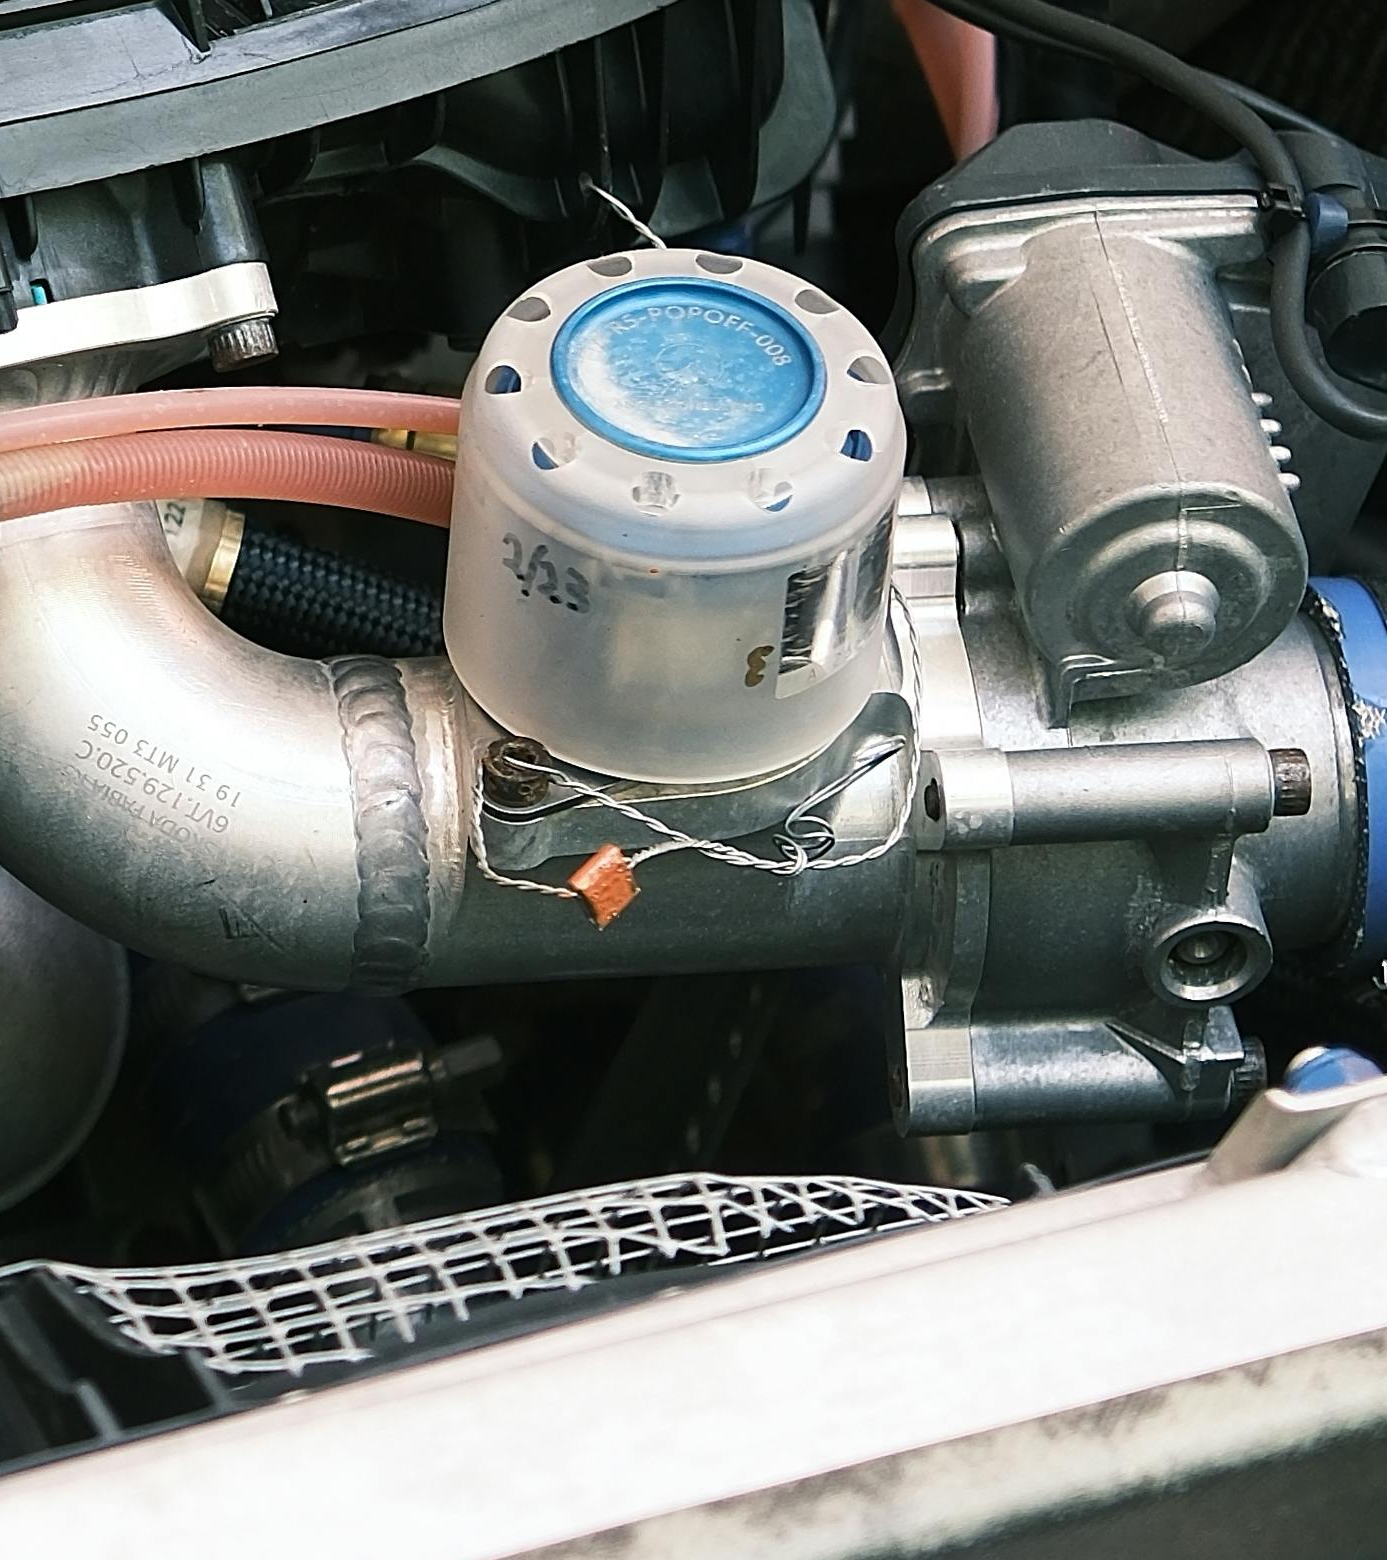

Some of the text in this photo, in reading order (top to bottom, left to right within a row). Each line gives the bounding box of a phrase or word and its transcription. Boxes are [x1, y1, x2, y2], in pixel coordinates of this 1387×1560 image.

[609, 304, 793, 369] RS-POPOFF-008
[74, 738, 230, 835] 6VT.129.520.C
[86, 713, 242, 809] 19 31 MT3 055
